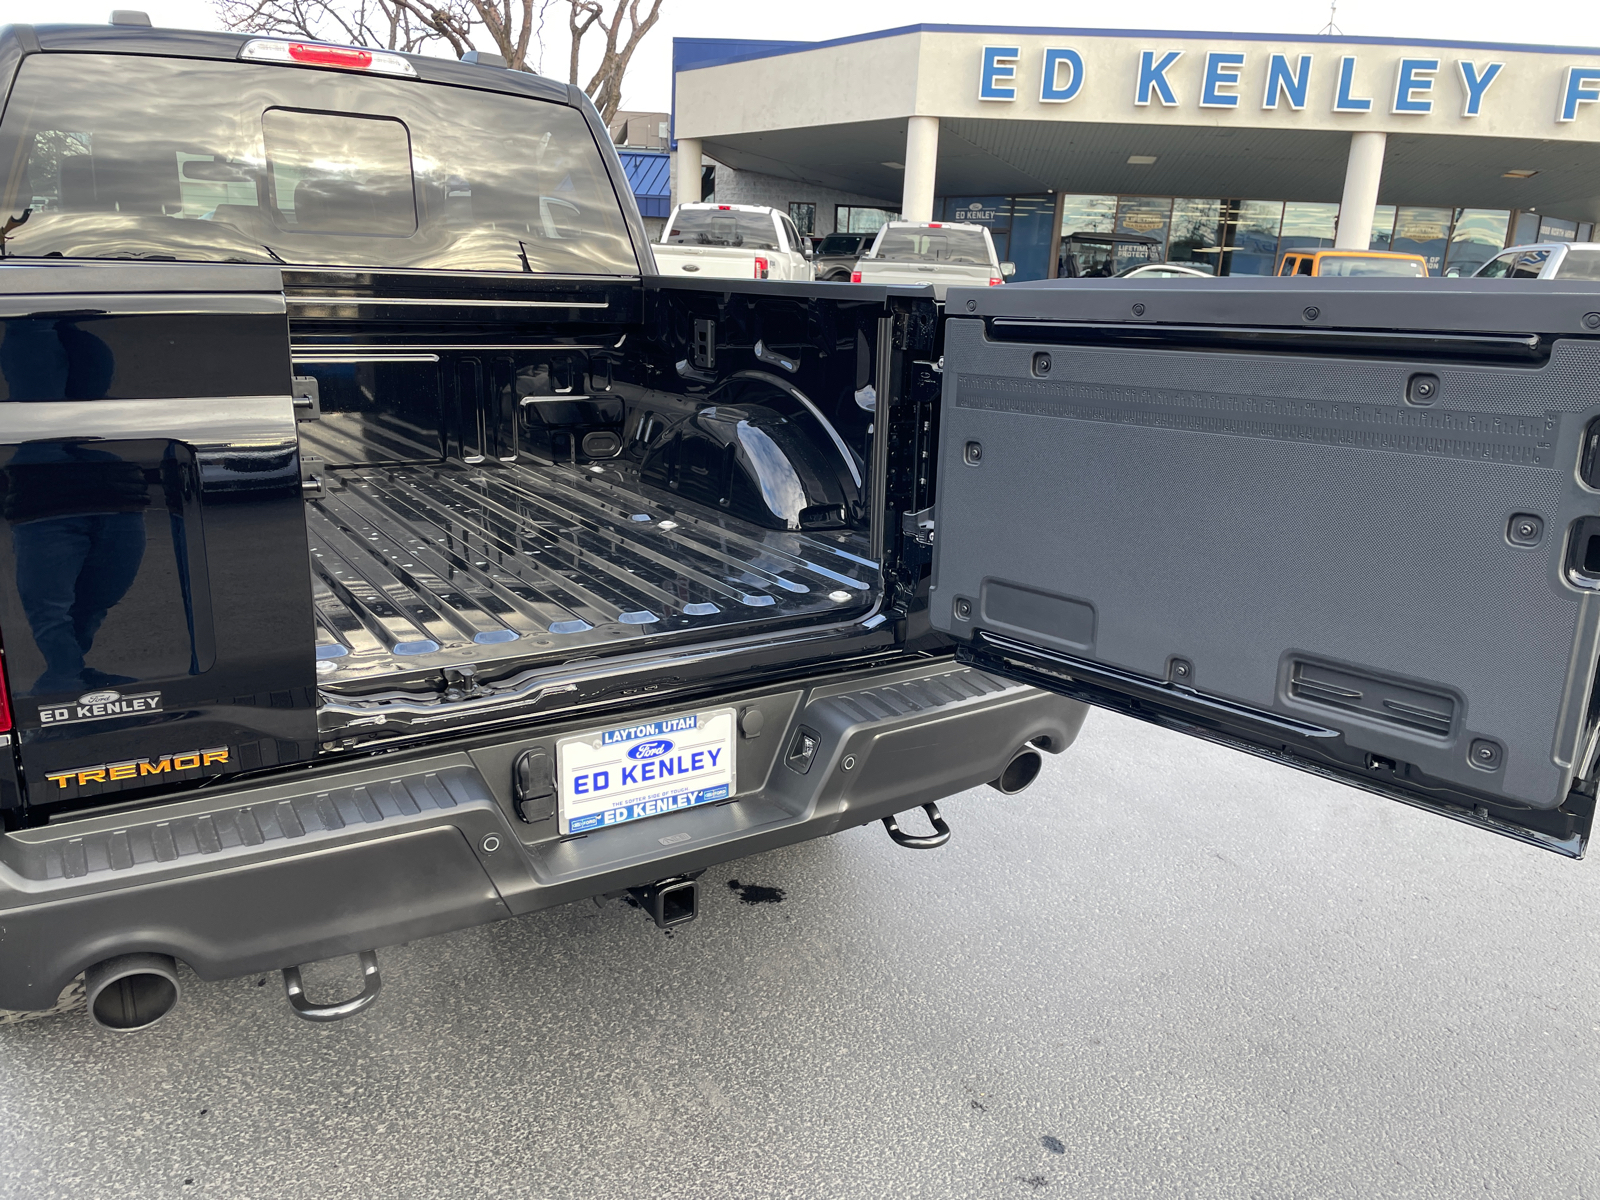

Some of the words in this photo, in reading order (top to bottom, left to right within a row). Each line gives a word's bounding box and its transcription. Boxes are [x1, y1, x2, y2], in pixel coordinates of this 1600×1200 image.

[978, 45, 1086, 104] ED
[1134, 49, 1506, 118] KENLEY
[955, 211, 965, 219] ED
[967, 211, 995, 219] KENLEY
[40, 709, 69, 722] ED
[78, 697, 160, 718] KENLEY
[88, 694, 111, 704] Ford
[604, 724, 659, 743] LAYTON,
[662, 716, 695, 732] UTAH
[636, 741, 665, 759] Ford
[45, 745, 229, 788] TREMOR
[574, 770, 609, 795] ED
[622, 748, 722, 786] KENLEY
[604, 808, 628, 825] ED
[633, 791, 698, 818] KENLEY
[625, 796, 646, 804] SOFTER
